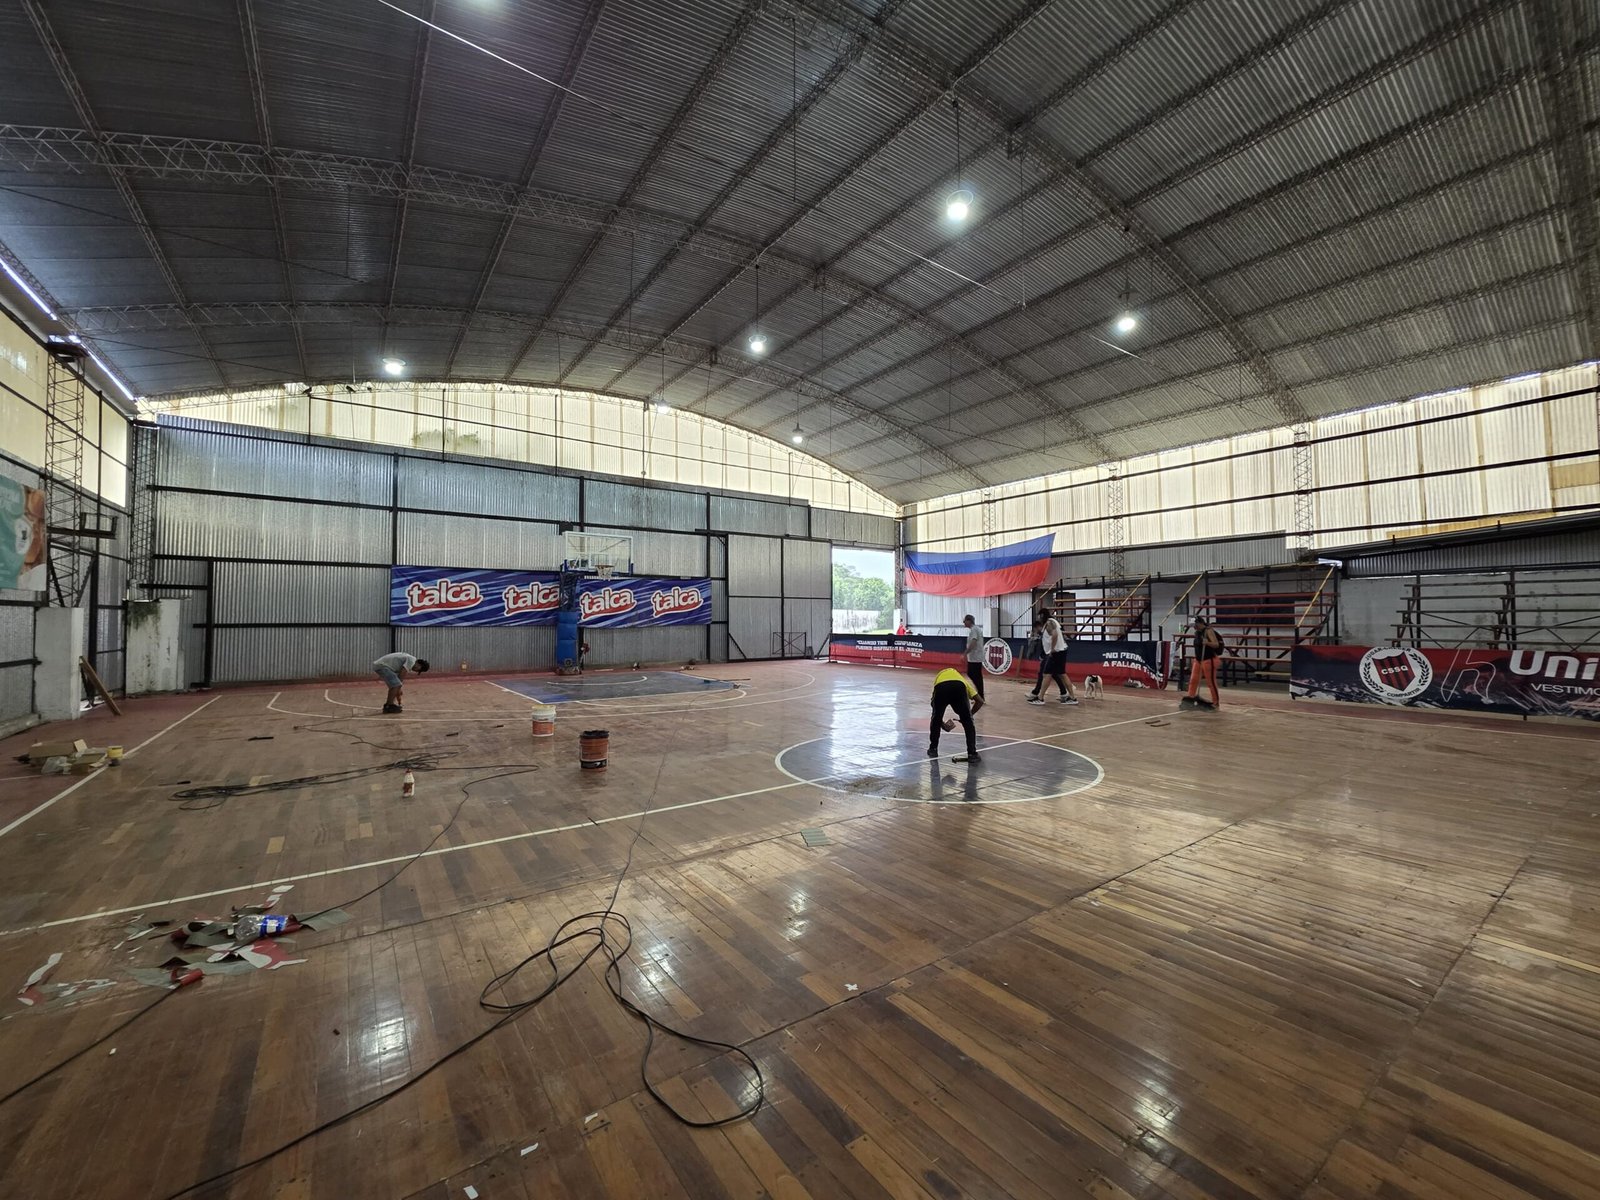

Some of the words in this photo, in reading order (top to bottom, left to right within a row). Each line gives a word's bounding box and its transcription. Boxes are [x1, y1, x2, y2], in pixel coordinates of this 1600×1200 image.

[407, 581, 478, 607] talca
[503, 585, 560, 609] talca
[581, 589, 634, 615] talca
[653, 589, 701, 613] talca
[1111, 660, 1141, 670] FALLAR
[1381, 665, 1408, 675] CSSQ
[1509, 650, 1599, 680] Uni
[1386, 687, 1421, 698] COMPARTIR
